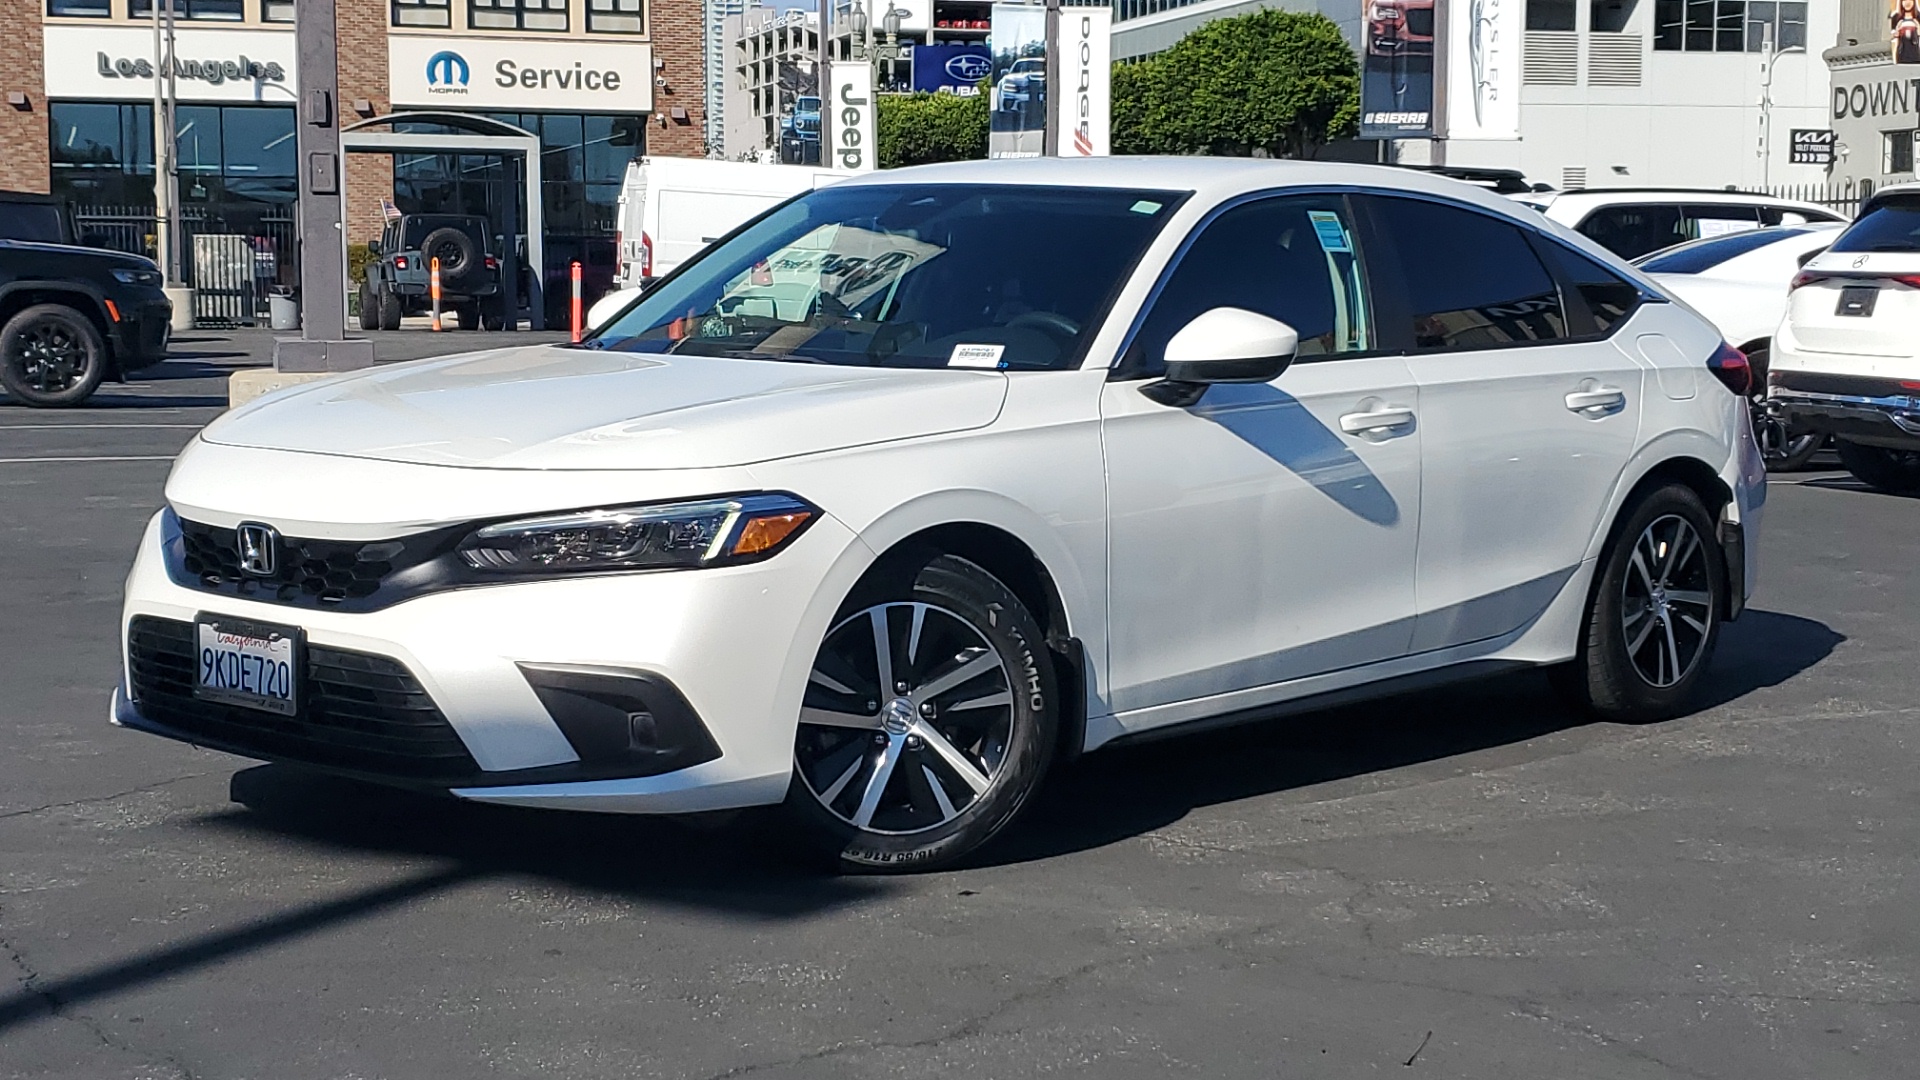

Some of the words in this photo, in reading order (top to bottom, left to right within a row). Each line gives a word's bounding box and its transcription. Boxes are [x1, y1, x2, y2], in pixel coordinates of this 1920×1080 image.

[97, 51, 154, 78] Los
[160, 53, 285, 85] Angeles
[495, 59, 621, 91] Service
[1077, 16, 1091, 142] DODGE
[428, 87, 468, 95] MOPAR
[837, 83, 867, 169] Jeep
[1374, 112, 1429, 124] SIERRA
[1794, 132, 1832, 143] KIA
[217, 632, 278, 651] California
[203, 647, 289, 700] 9KDE720
